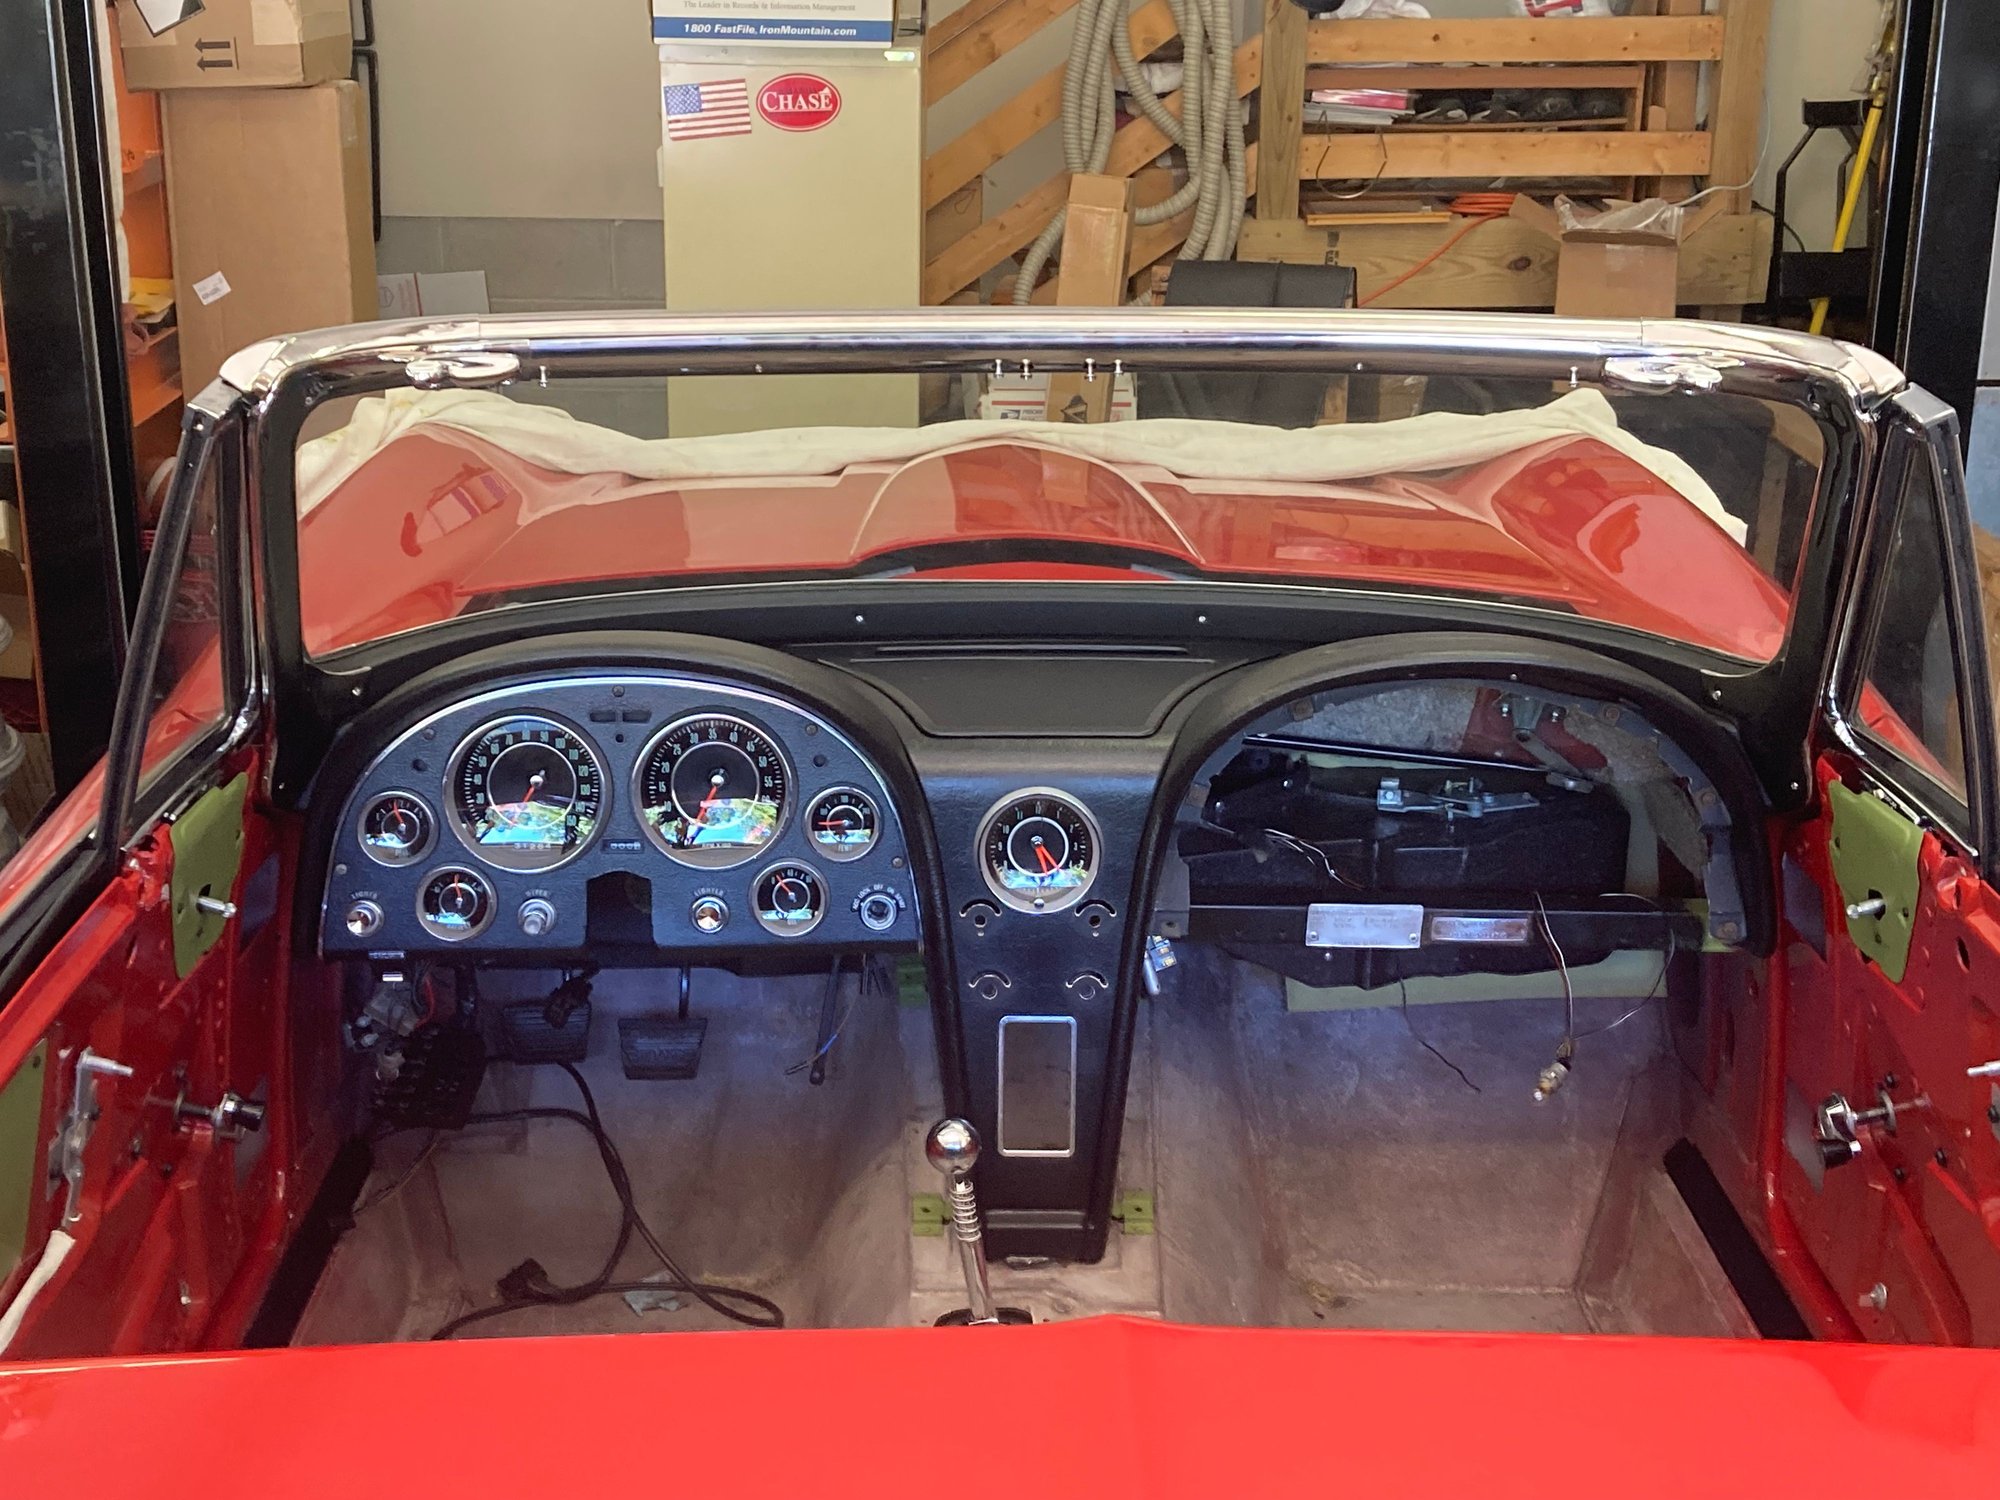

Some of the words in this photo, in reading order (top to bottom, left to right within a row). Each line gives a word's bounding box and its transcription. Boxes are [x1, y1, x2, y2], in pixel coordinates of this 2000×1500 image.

[698, 1, 722, 9] Leader
[732, 2, 759, 10] Records
[770, 3, 811, 11] Information
[812, 3, 856, 12] Management
[760, 25, 857, 36] IronMountain.com
[762, 91, 833, 111] CHASE
[689, 733, 699, 744] 30
[708, 728, 718, 739] 35
[729, 732, 738, 743] 40
[673, 745, 682, 756] 25
[746, 742, 755, 752] 45
[759, 756, 768, 767] 50
[661, 762, 670, 773] 20
[658, 781, 667, 793] 15
[764, 776, 773, 788] 55
